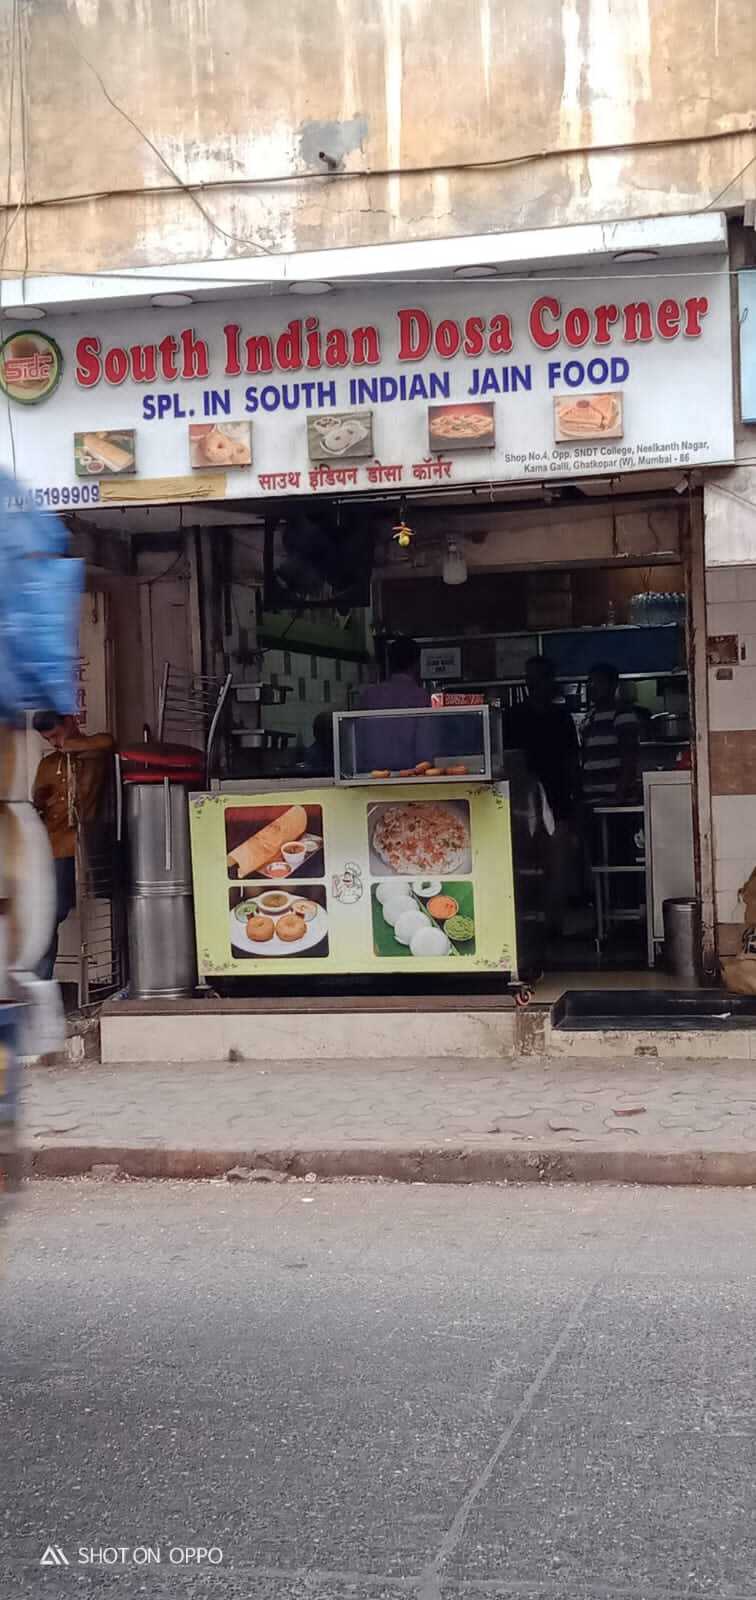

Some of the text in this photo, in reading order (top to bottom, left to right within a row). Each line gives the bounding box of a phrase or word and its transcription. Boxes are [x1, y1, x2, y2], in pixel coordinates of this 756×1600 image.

[75, 295, 709, 388] South Indian Dosa Corner
[142, 356, 630, 420] SPL. IN SOUTH INDIAN JAIN FOOD
[505, 453, 526, 463] Shop
[574, 447, 598, 458] SNDT
[600, 446, 634, 457] College,
[636, 442, 680, 454] Neelkanth
[573, 458, 617, 470] Ghatkopar
[638, 454, 672, 465] Mumbai
[258, 457, 453, 491] साउथ इंडियन डोसा कॉर्नर
[7, 485, 100, 508] 05199909
